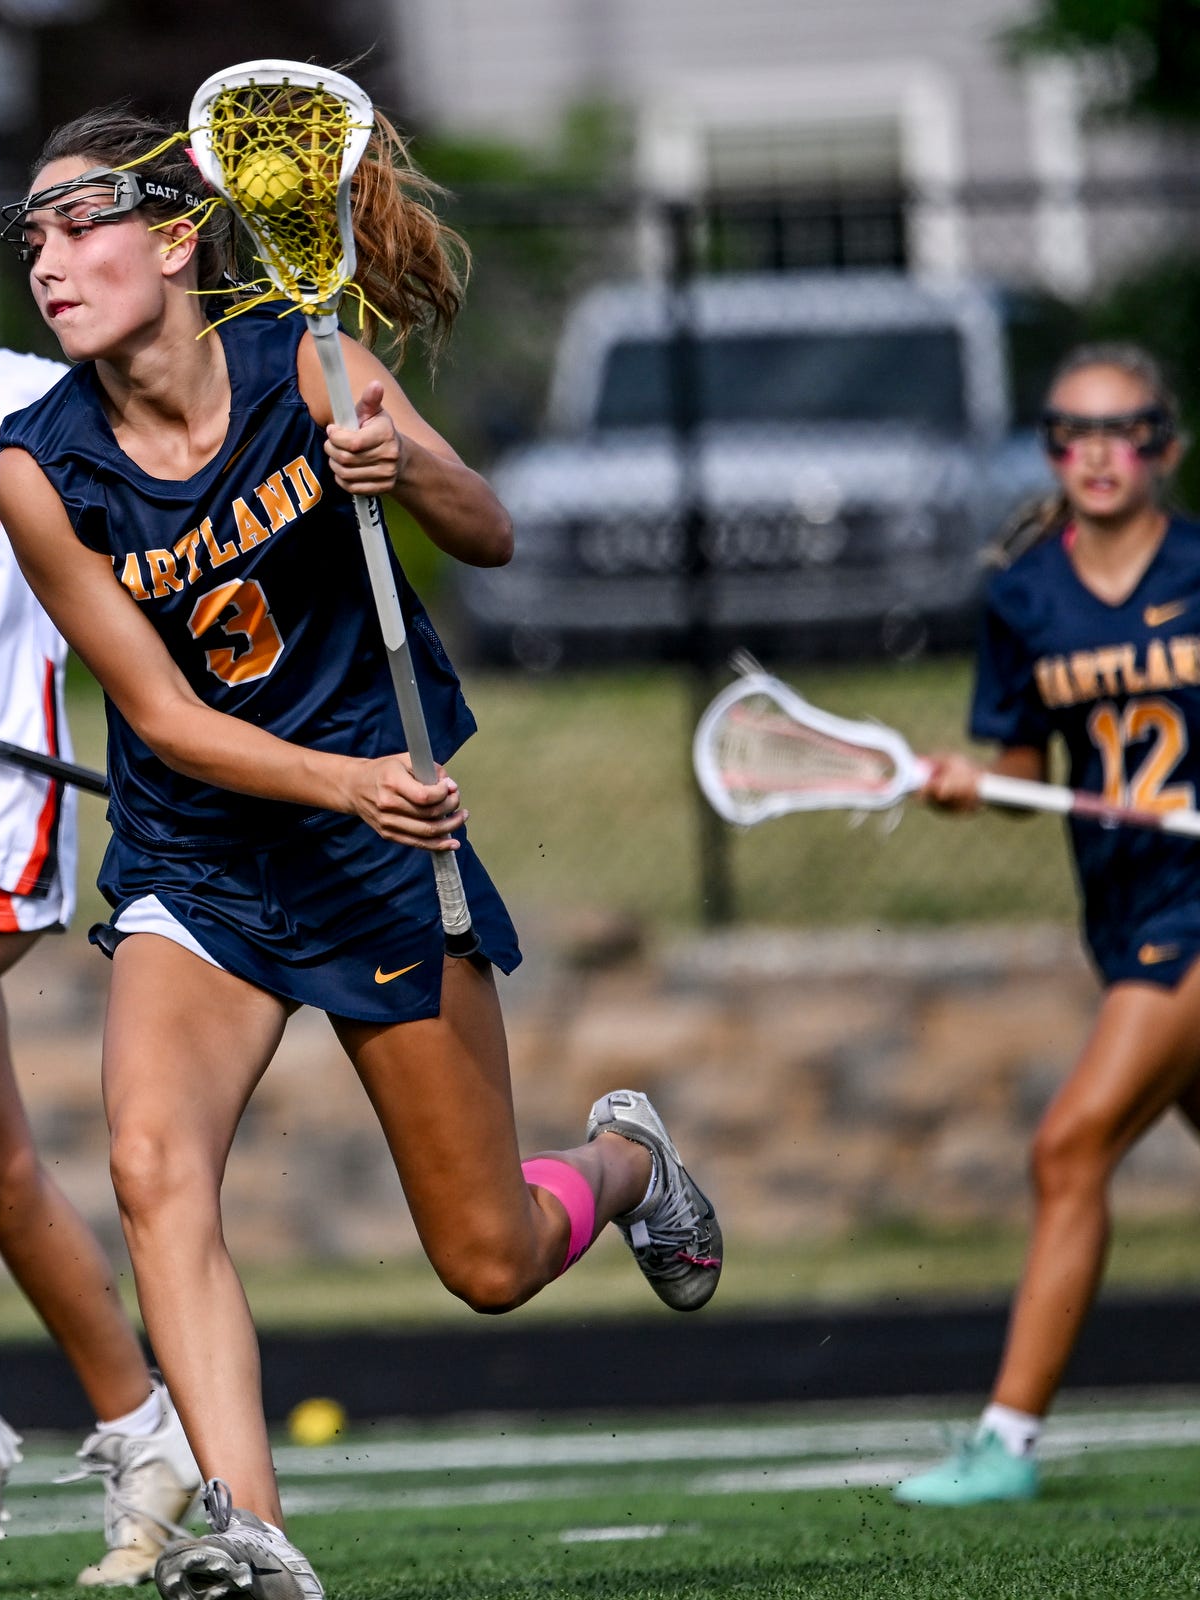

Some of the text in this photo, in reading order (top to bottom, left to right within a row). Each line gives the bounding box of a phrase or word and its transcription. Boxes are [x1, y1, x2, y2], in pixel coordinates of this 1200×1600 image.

[145, 182, 179, 201] GAIT
[111, 455, 323, 601] ARTLAND
[186, 577, 285, 688] 3
[1087, 695, 1196, 828] 12
